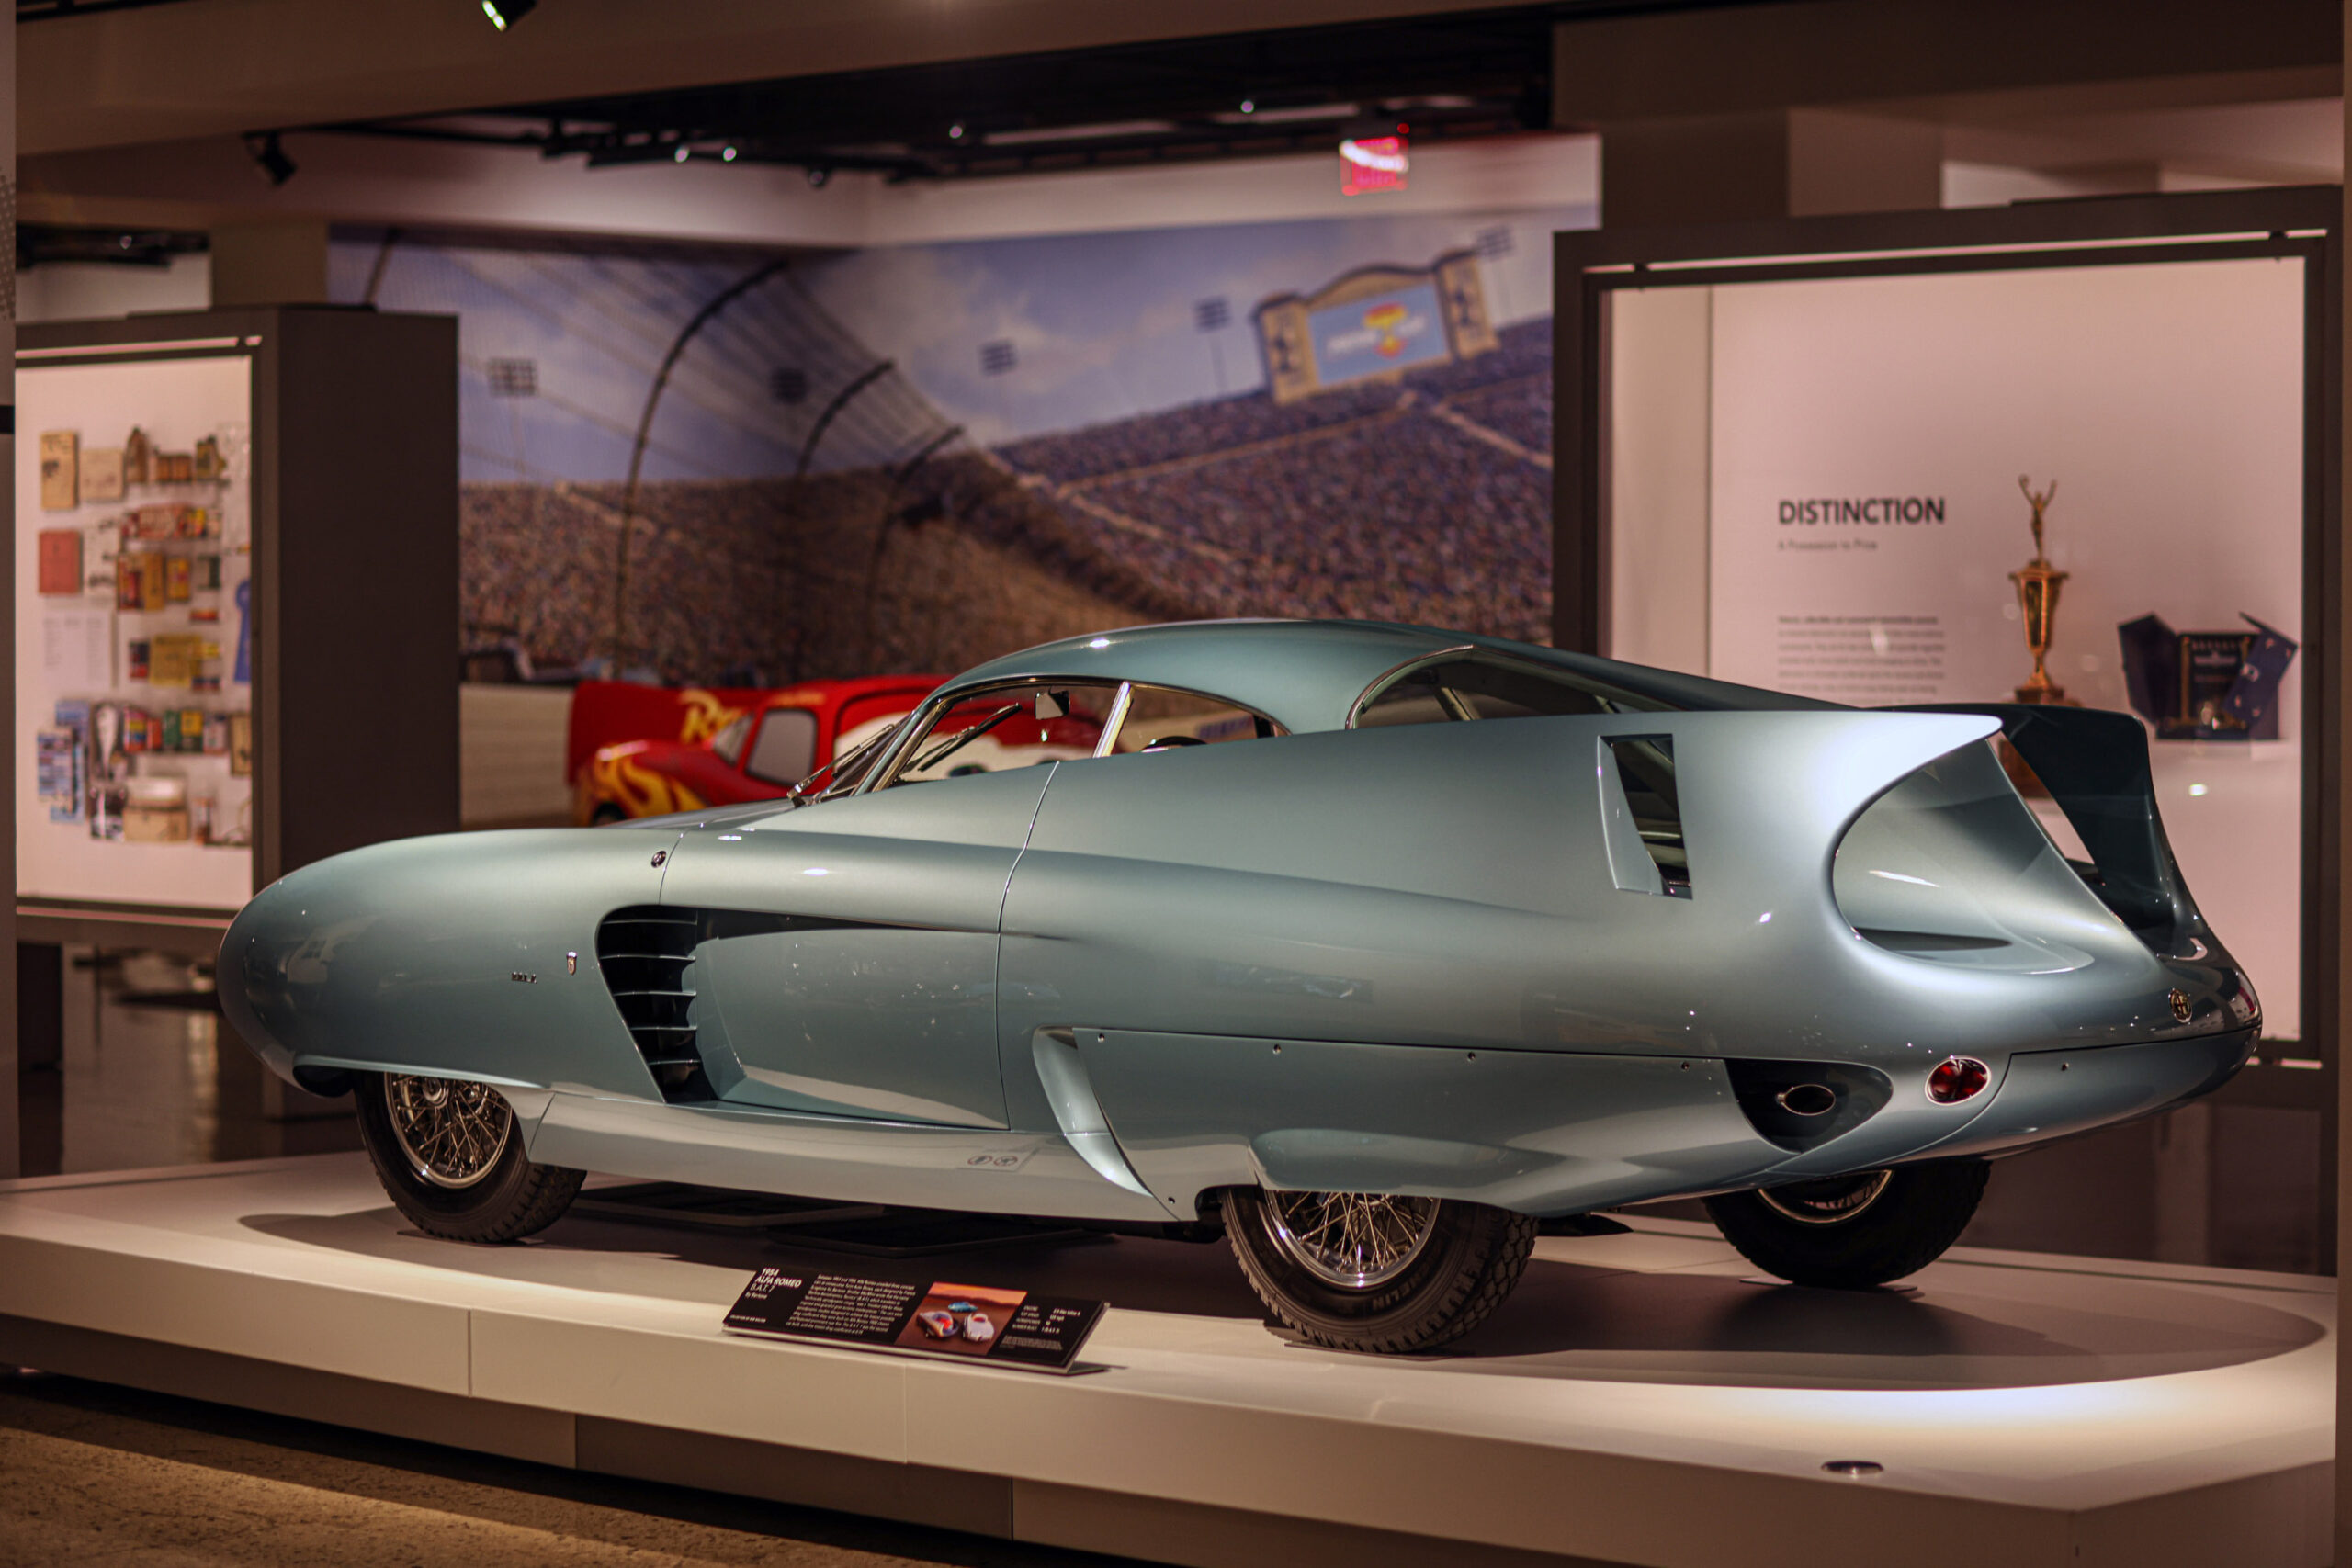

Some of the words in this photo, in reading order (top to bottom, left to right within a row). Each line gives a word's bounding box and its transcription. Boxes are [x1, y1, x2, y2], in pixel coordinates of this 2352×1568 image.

[1779, 497, 1945, 525] DISTINCTION
[762, 1268, 779, 1277] 1954
[754, 1275, 774, 1285] ALFA
[774, 1277, 803, 1289] ROMEO
